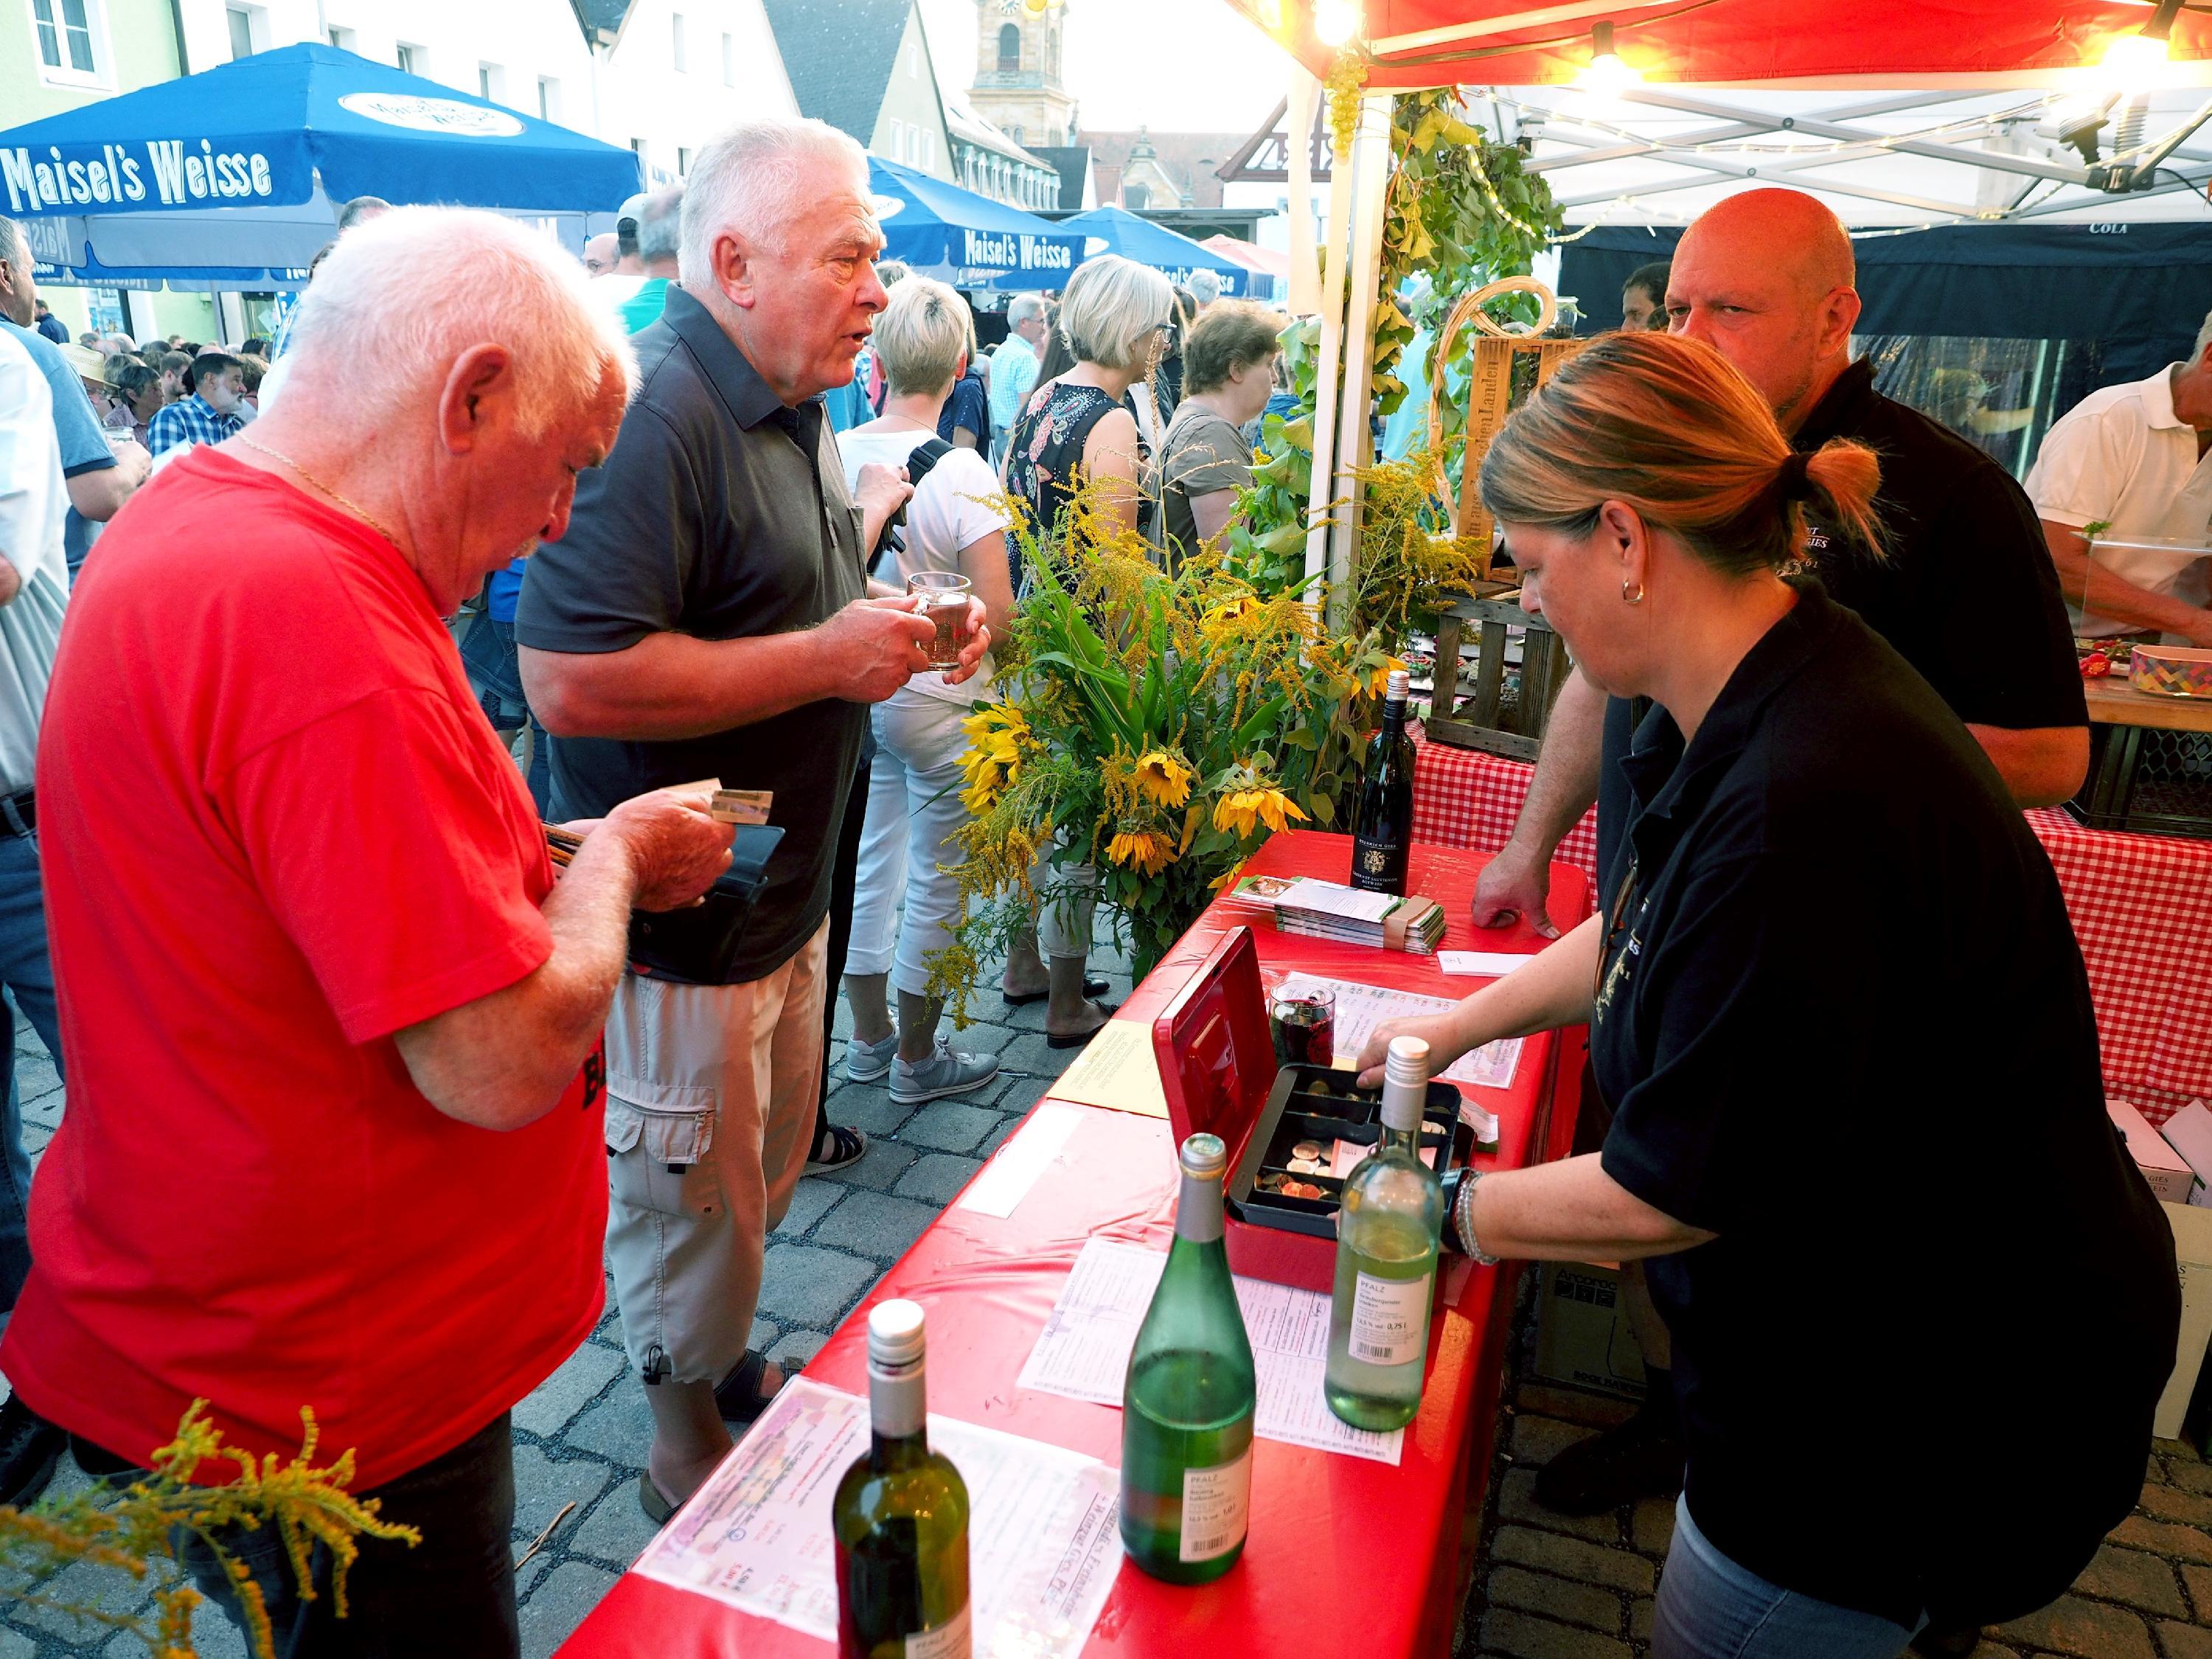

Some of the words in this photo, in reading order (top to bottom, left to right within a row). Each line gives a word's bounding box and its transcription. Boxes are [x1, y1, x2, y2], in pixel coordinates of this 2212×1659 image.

[0, 145, 146, 212] Maisel's
[147, 139, 272, 204] Weisse
[2088, 223, 2127, 234] COLA
[964, 229, 1017, 266] Maisel's
[1019, 234, 1071, 270] Weisse
[1478, 361, 1499, 417] Landen
[1360, 1280, 1385, 1293] PFALZ
